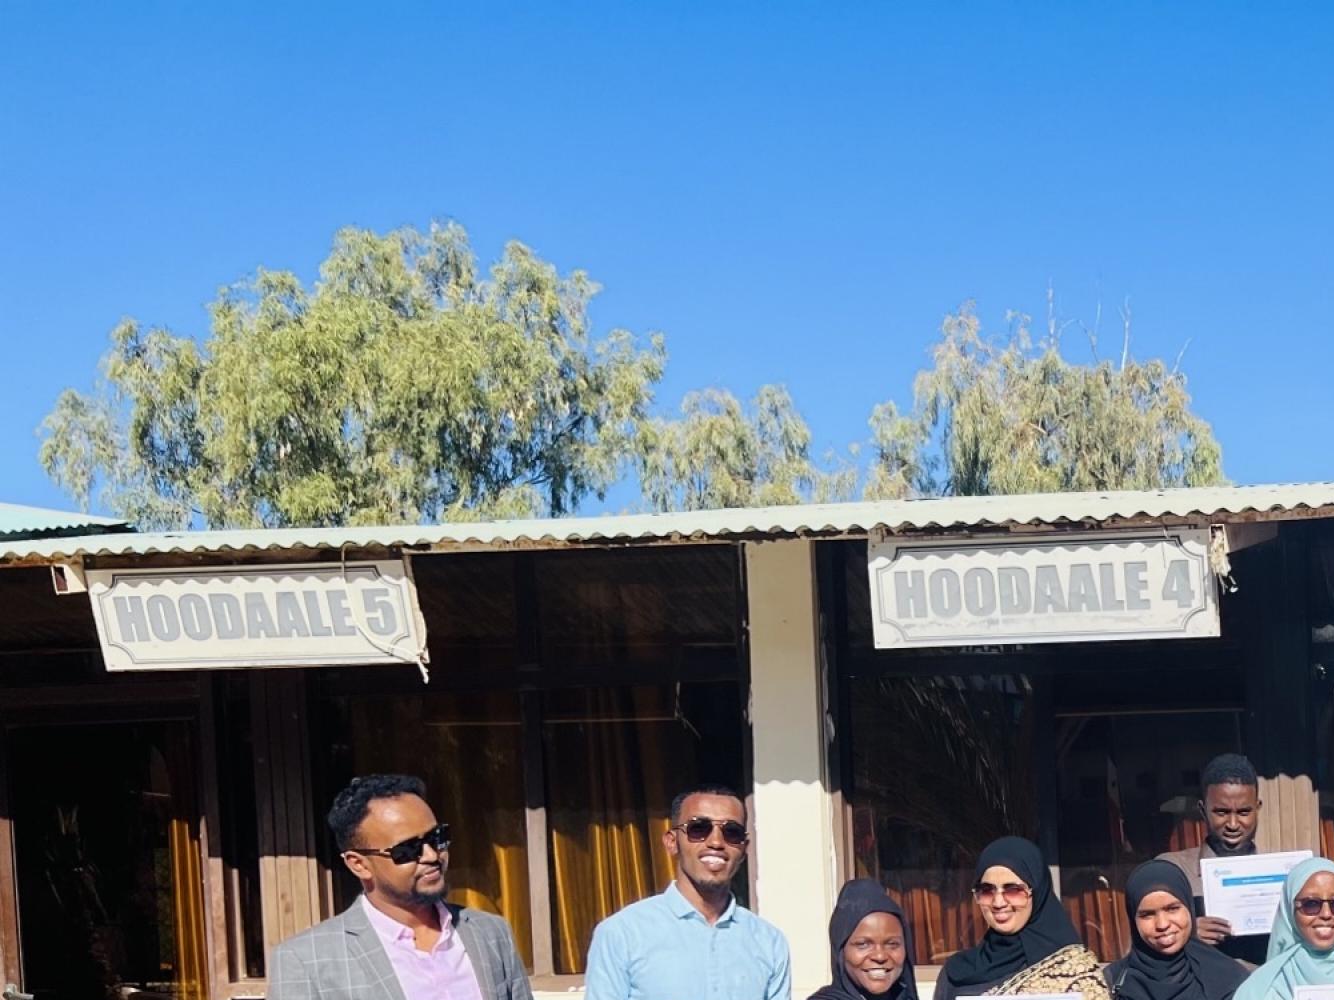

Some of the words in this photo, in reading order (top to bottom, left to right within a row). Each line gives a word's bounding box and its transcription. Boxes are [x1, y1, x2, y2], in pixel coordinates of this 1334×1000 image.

[112, 589, 358, 643] HOODAALE
[361, 587, 398, 636] 5
[894, 560, 1151, 619] HOODAALE
[1161, 559, 1195, 609] 4
